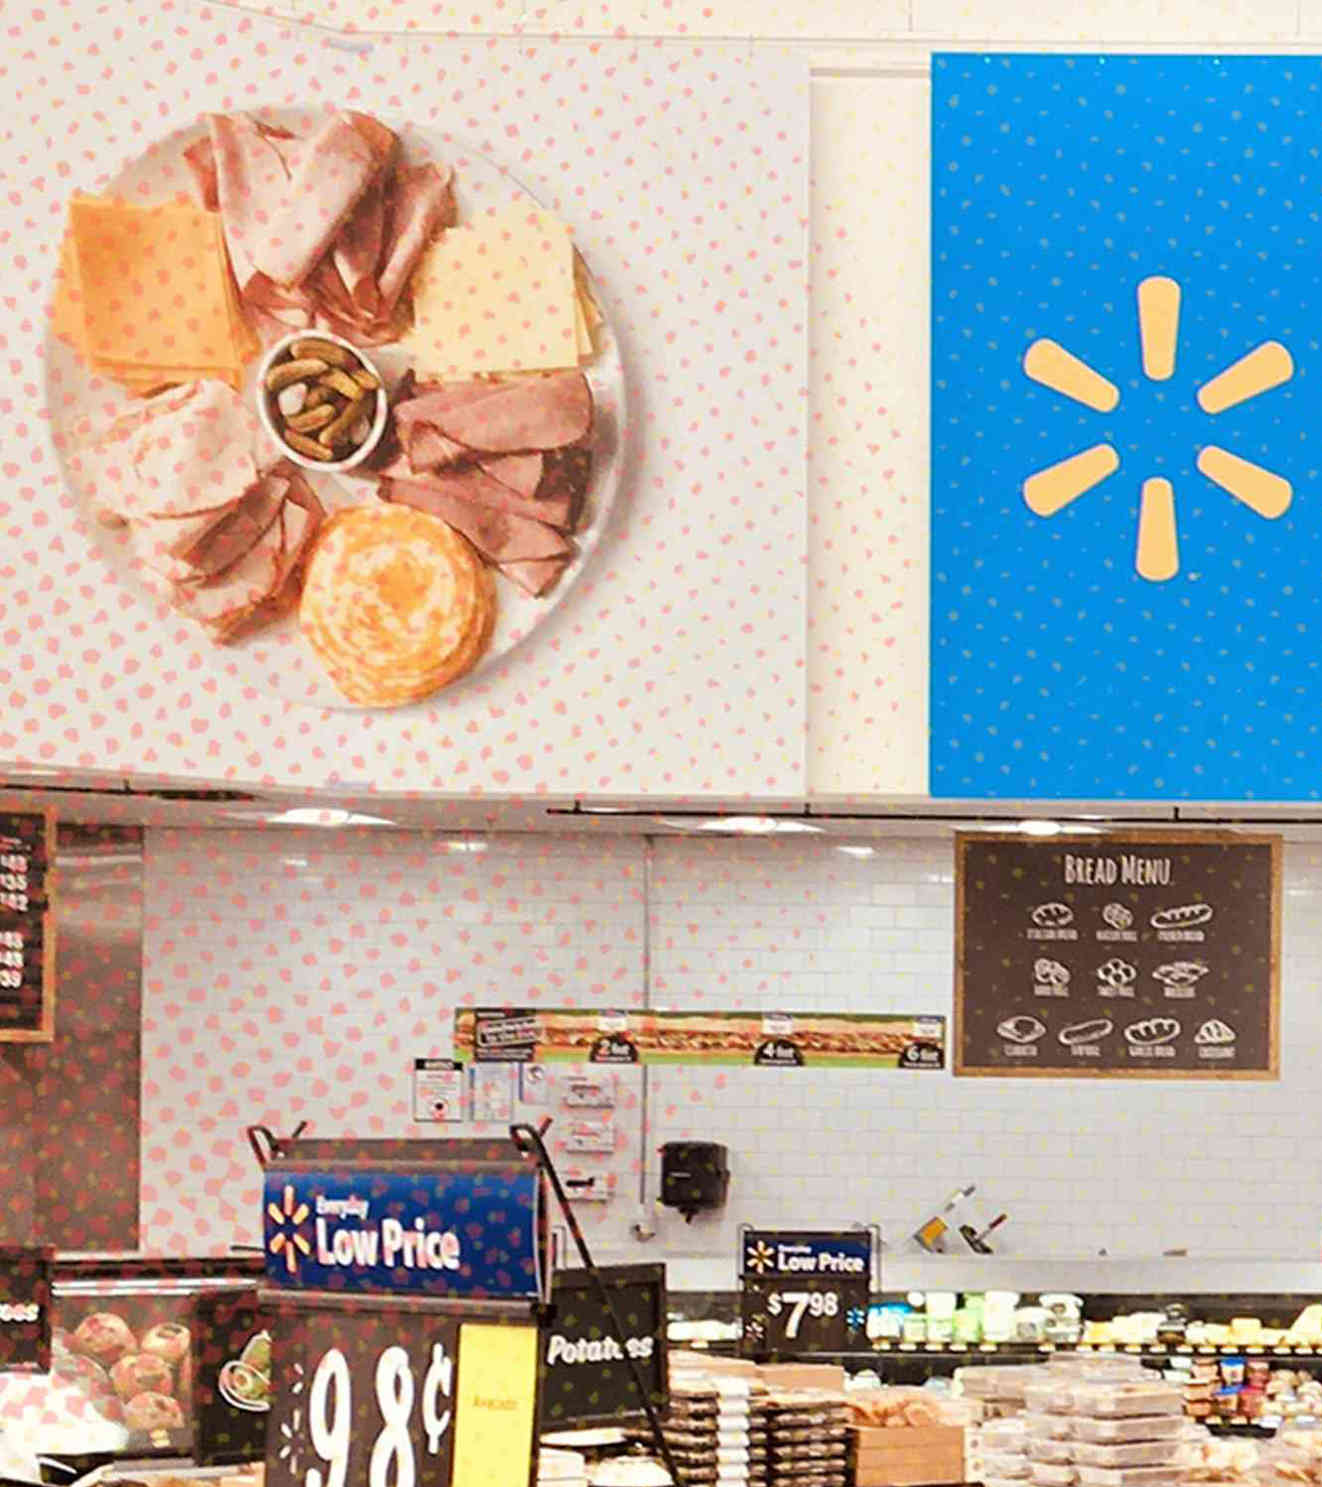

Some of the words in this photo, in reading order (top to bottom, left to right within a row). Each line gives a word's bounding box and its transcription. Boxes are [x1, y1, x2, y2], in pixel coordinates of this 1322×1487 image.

[1064, 855, 1118, 884] BREAD
[1121, 855, 1170, 885] MENU
[316, 1217, 380, 1268] Low
[382, 1216, 461, 1271] Price
[777, 1253, 817, 1272] Low
[819, 1252, 864, 1273] Price
[546, 1332, 655, 1366] Potates
